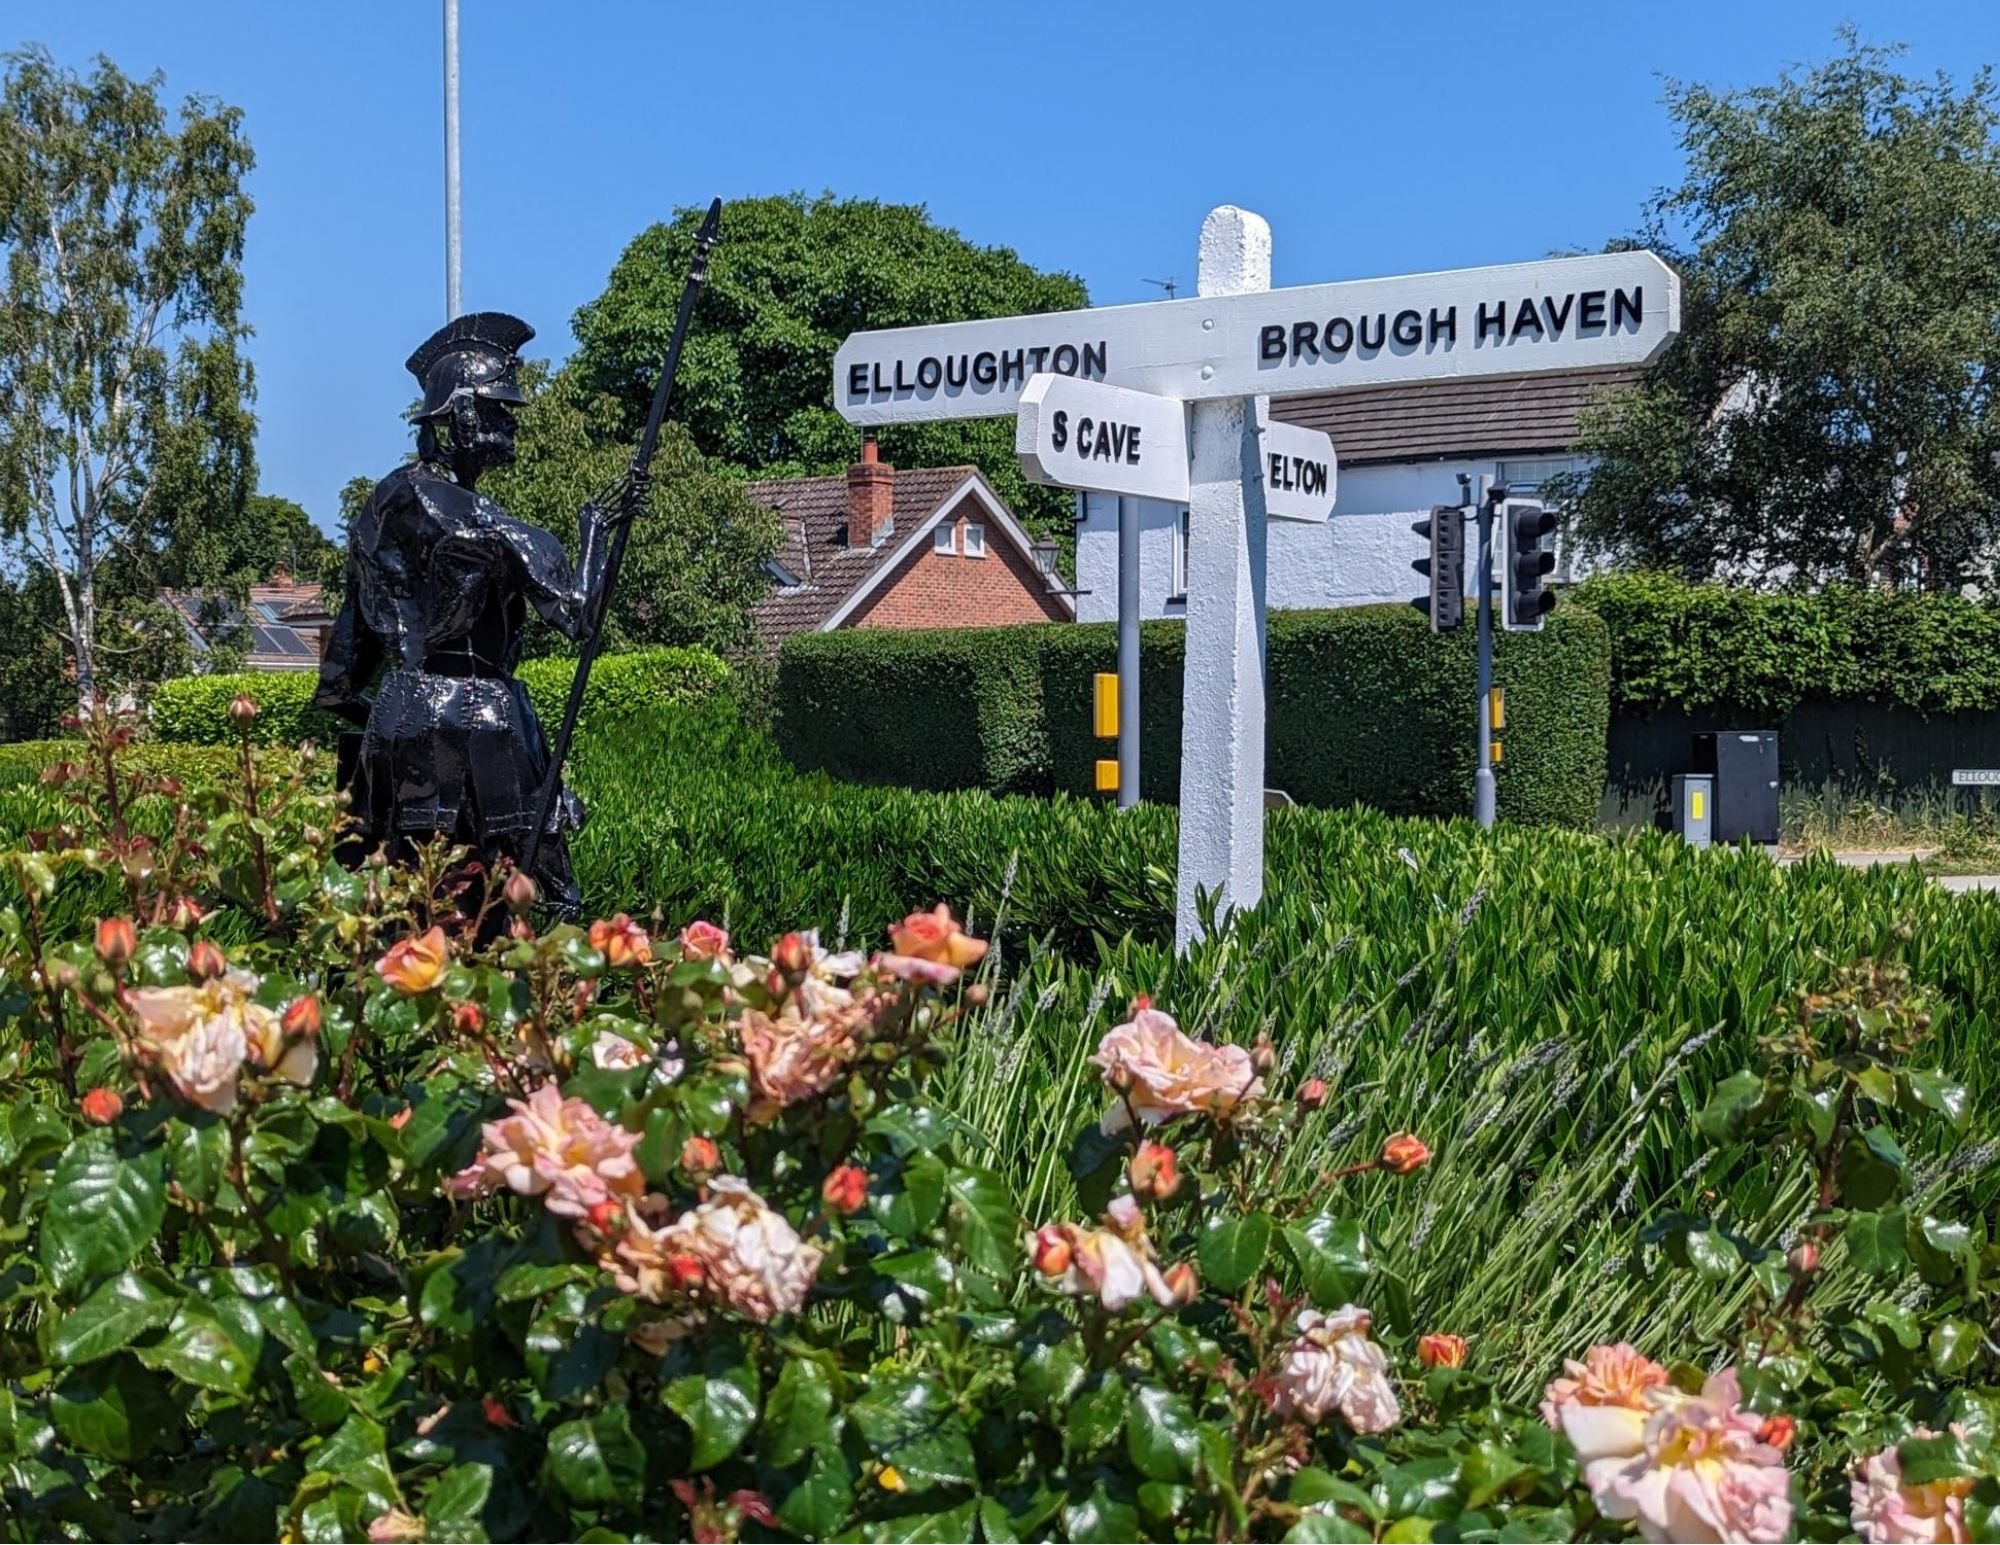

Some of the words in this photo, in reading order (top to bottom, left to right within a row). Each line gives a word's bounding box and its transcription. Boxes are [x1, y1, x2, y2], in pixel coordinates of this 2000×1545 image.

[1261, 306, 1457, 360] BROUGH
[1479, 286, 1643, 339] HAVEN
[849, 341, 1107, 395] ELLOUGHTON
[1052, 410, 1068, 447] S
[1077, 416, 1141, 461] CAVE
[1267, 452, 1328, 496] ELTON
